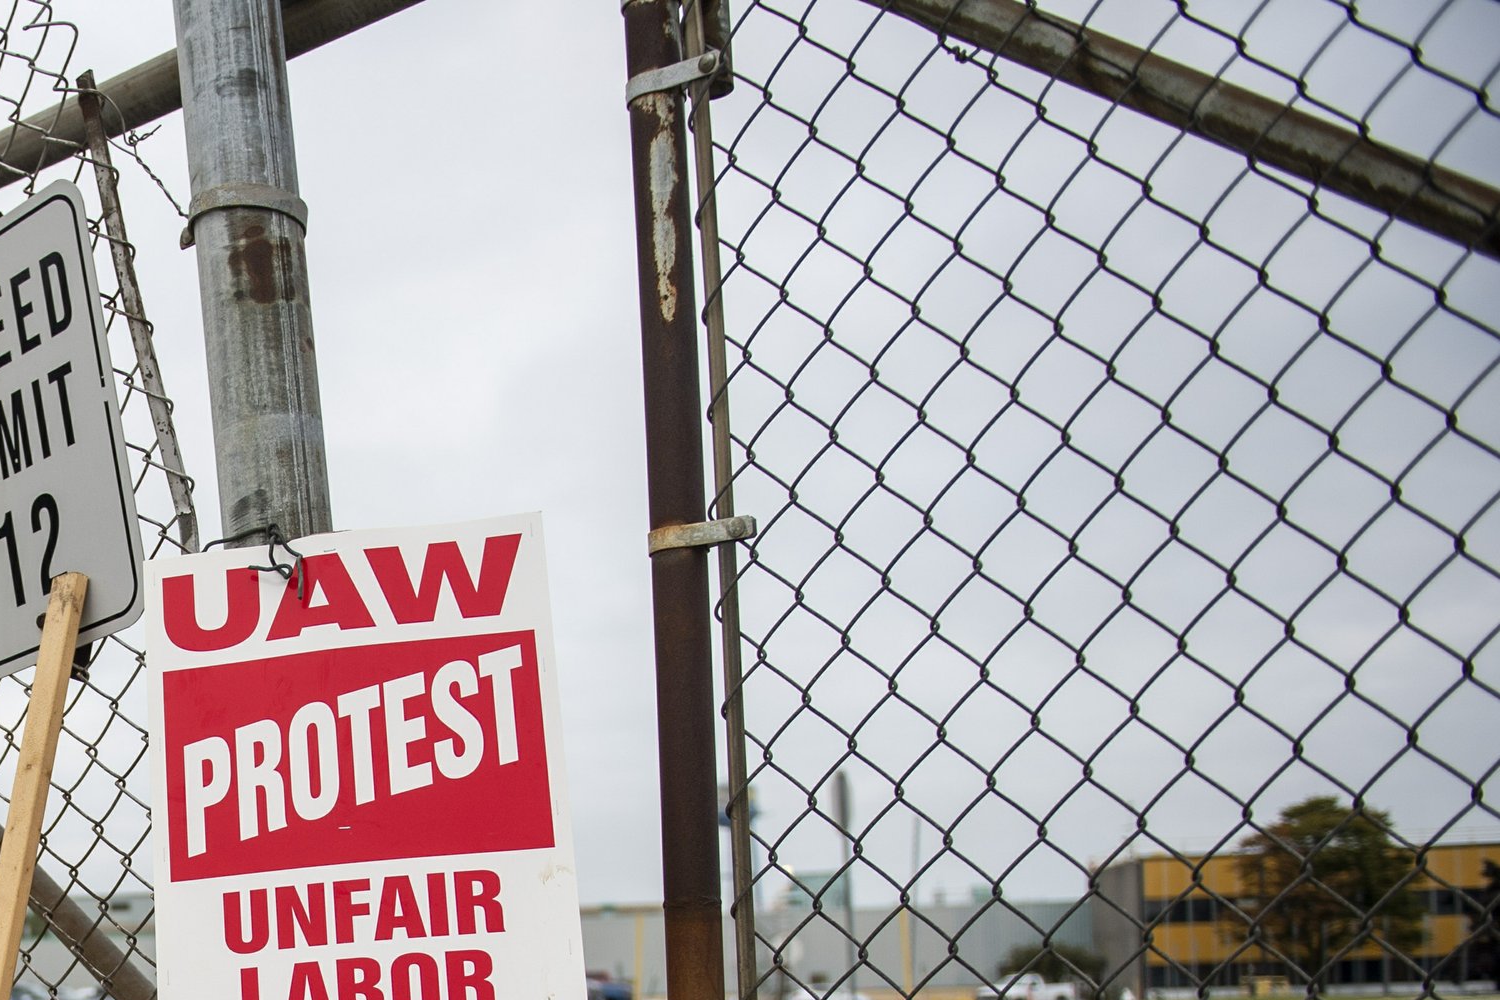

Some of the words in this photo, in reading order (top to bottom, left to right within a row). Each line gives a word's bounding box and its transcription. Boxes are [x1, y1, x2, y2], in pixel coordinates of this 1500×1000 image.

[161, 533, 523, 652] UAW
[183, 644, 523, 859] PROTEST
[222, 870, 506, 954] UNFAIR
